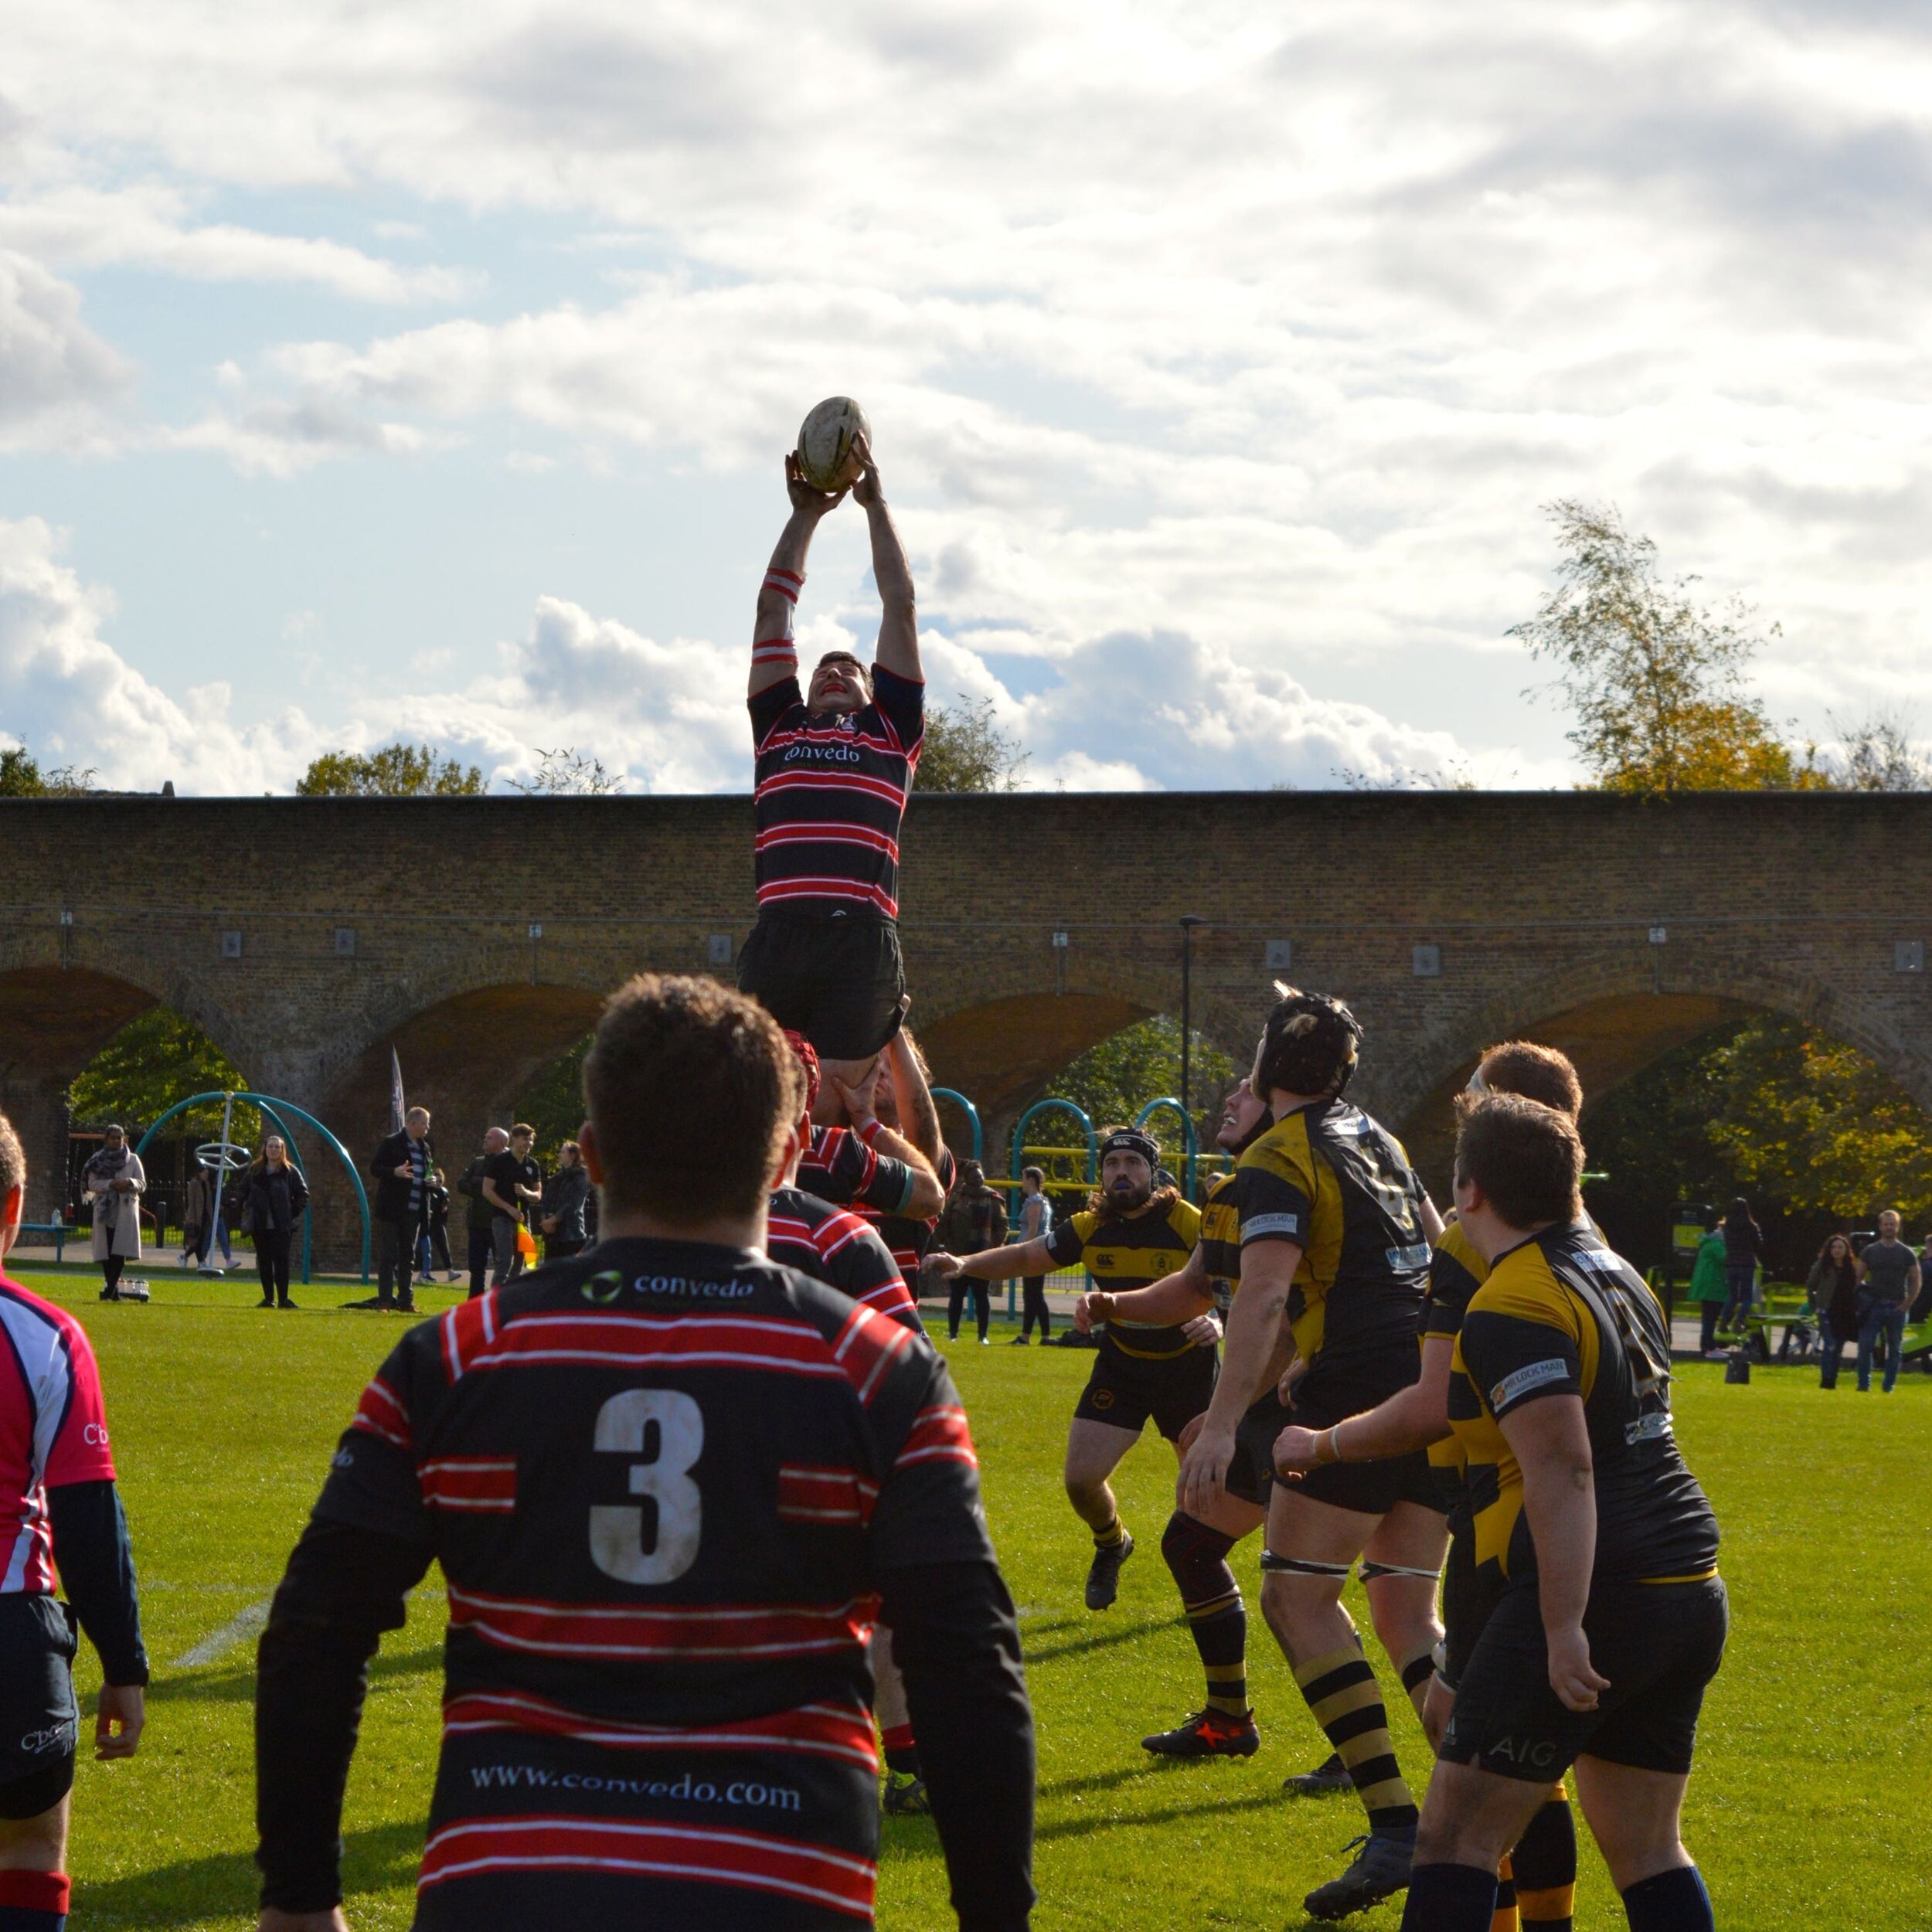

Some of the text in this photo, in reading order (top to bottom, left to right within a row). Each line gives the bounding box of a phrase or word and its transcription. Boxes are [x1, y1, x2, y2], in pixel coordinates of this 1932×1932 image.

[784, 745, 860, 762] convedo
[634, 1275, 754, 1298] convedo
[1515, 1365, 1540, 1383] LOCK
[1540, 1361, 1564, 1373] MAN
[589, 1388, 705, 1585] 3
[1488, 1735, 1557, 1767] AIG
[470, 1765, 801, 1811] www.convedo.com
